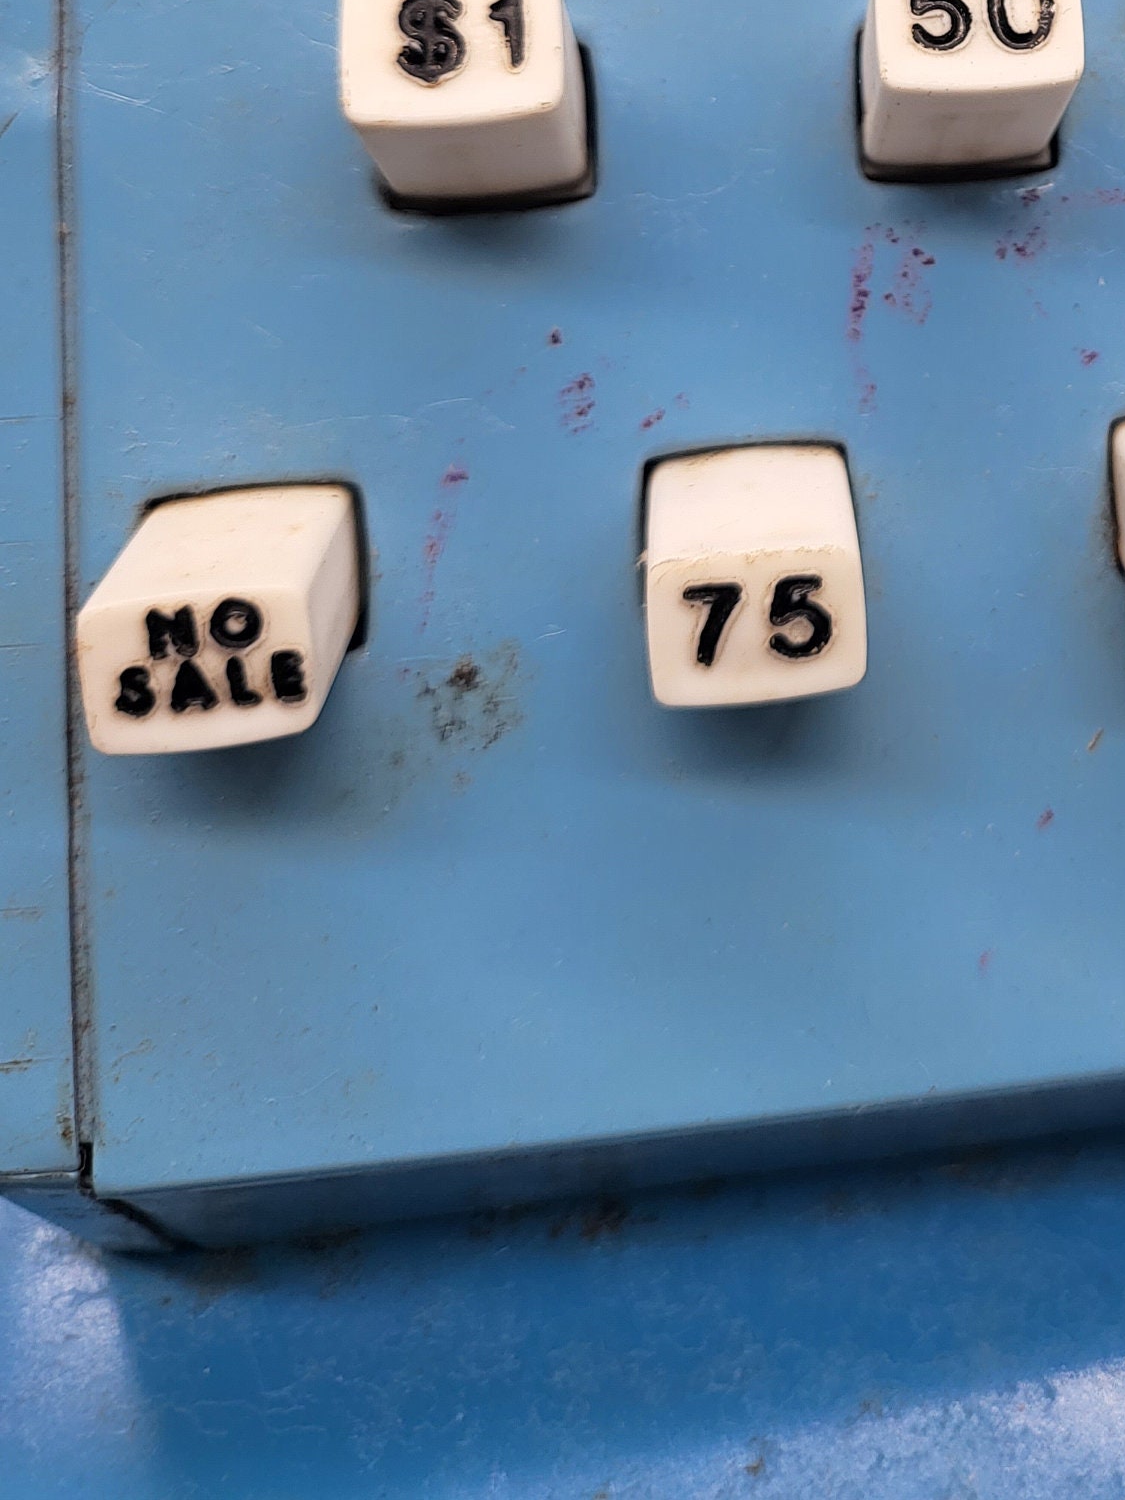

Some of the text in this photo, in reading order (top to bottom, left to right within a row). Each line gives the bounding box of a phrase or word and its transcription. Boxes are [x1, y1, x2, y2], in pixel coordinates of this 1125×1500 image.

[144, 598, 263, 660] NO
[682, 574, 834, 667] 75
[114, 650, 308, 717] SALE
